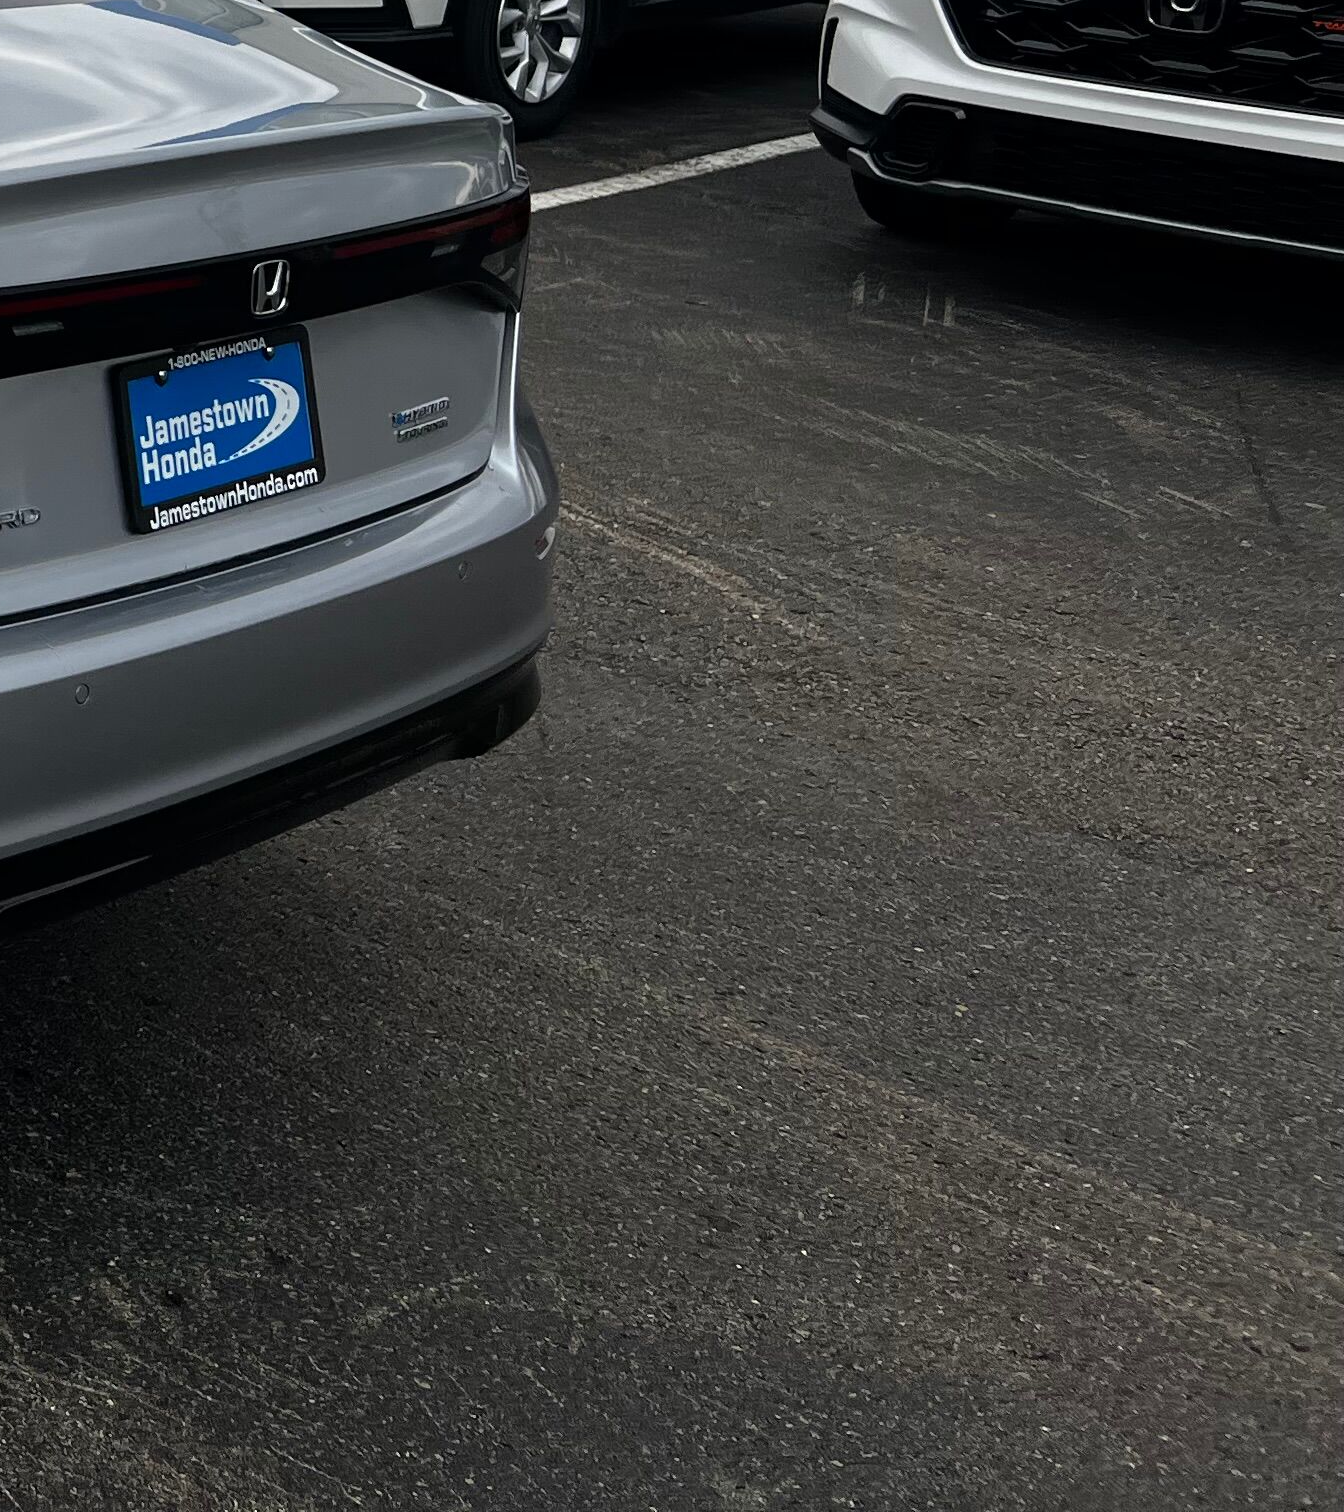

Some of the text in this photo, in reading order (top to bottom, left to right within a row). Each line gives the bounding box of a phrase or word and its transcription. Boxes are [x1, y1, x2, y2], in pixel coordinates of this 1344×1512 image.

[167, 336, 267, 371] 1-800-NEW-HONDA
[139, 392, 270, 449] Jamestown
[141, 438, 218, 485] Honda
[149, 466, 319, 530] JamestownHonda.com
